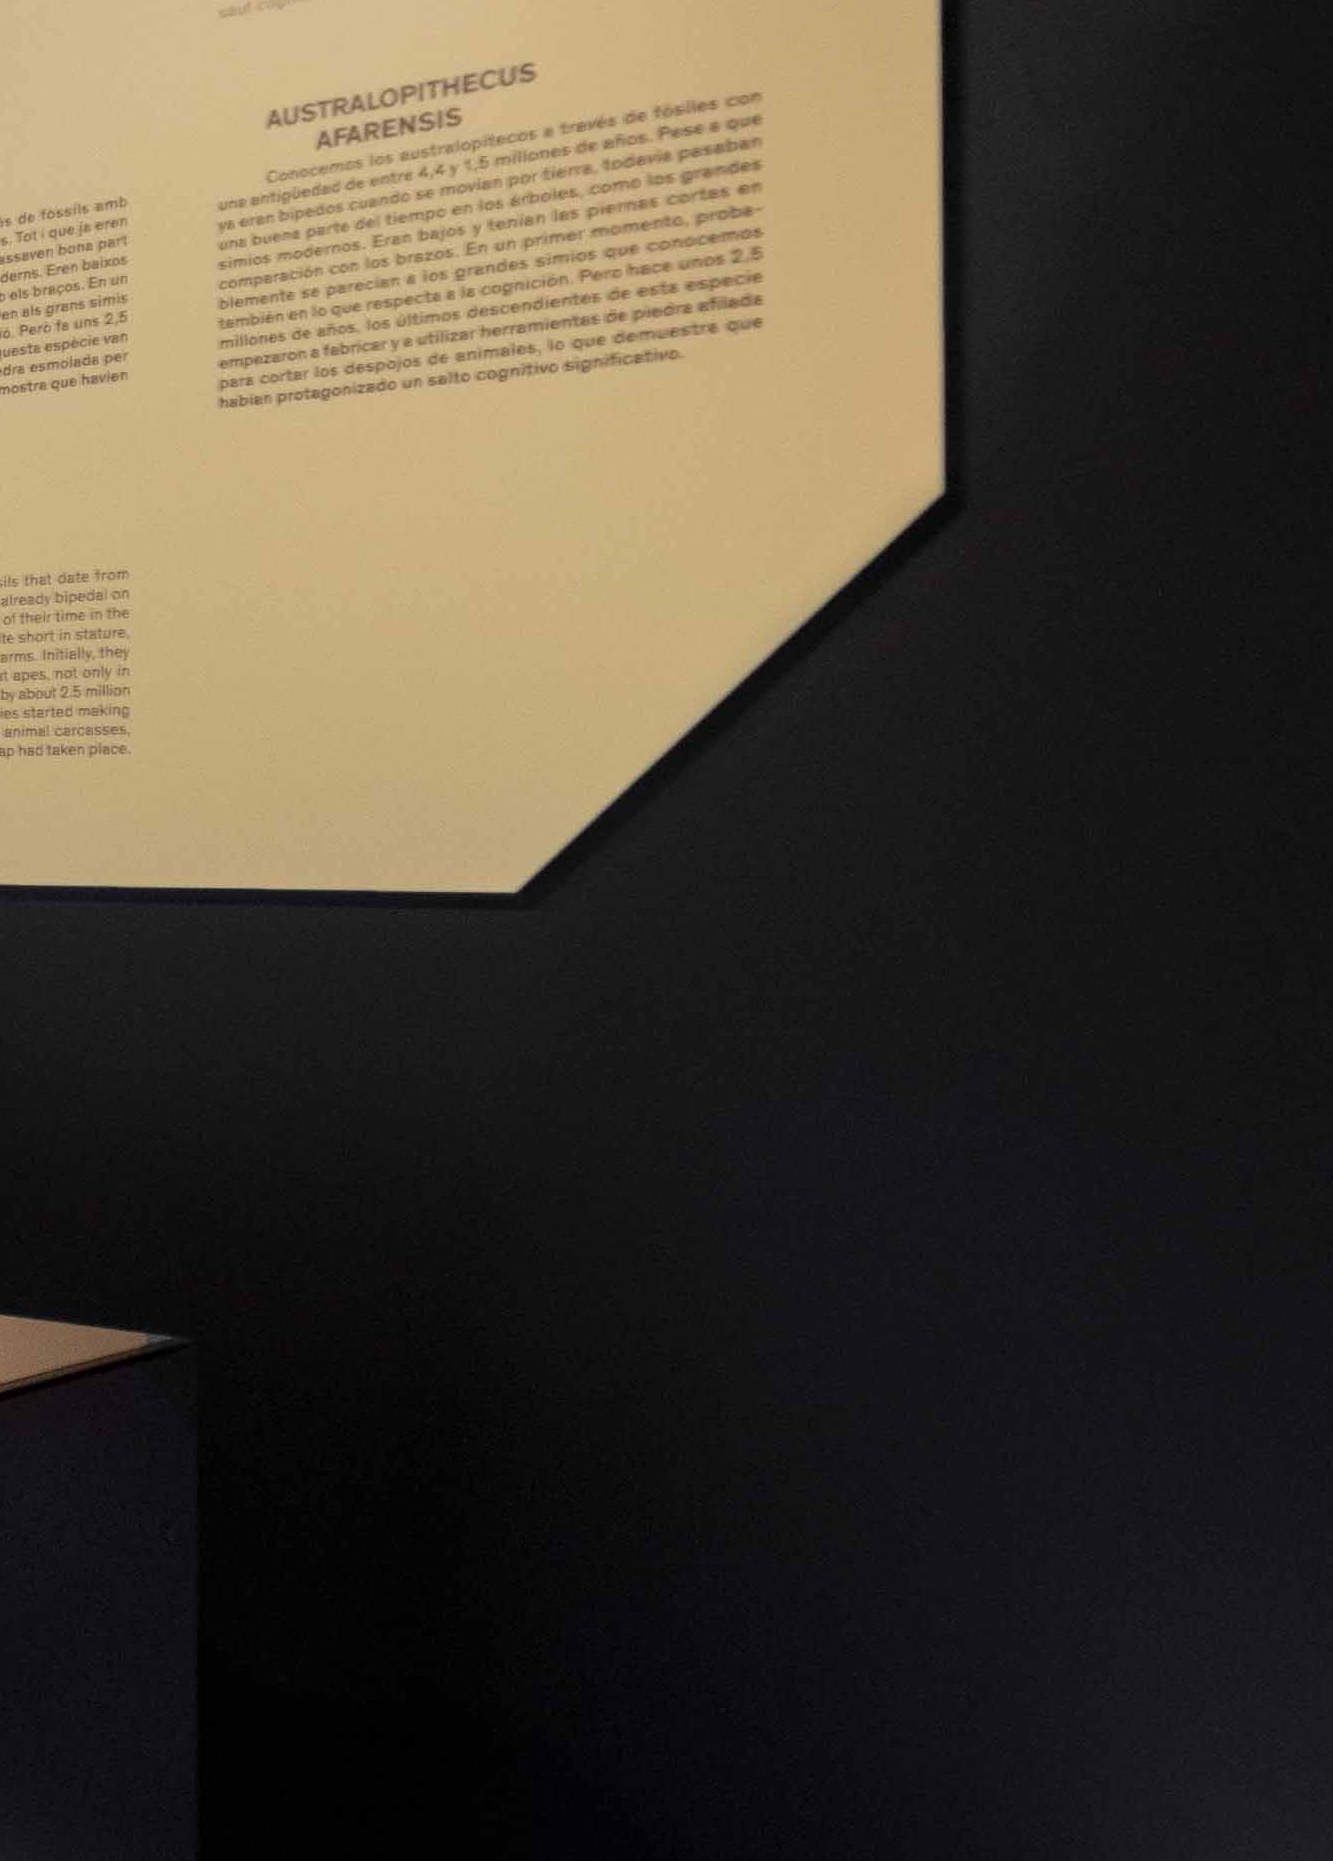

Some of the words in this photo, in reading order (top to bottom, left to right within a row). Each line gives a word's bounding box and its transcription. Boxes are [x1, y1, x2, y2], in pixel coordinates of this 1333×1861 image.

[265, 61, 538, 129] AUSTRALOPITHECUS
[315, 106, 463, 150] AFARENSIS
[16, 212, 35, 224] de
[93, 195, 128, 211] amb
[20, 304, 41, 317] als
[44, 300, 85, 317] grans
[88, 292, 128, 308] simis
[102, 332, 128, 344] van
[28, 354, 99, 372] esmolada
[102, 351, 128, 366] per
[49, 377, 77, 392] que
[79, 371, 128, 385] havien
[274, 378, 397, 405] protagonizado
[400, 377, 423, 389] un
[426, 370, 471, 386] salto
[473, 362, 559, 381] cognitivo
[561, 349, 684, 372] significativo.
[22, 572, 51, 585] that
[56, 570, 89, 583] date
[93, 568, 130, 580] from
[17, 629, 54, 642] short
[57, 629, 71, 640] in
[74, 626, 129, 639] stature,
[0, 652, 37, 662] arms.
[41, 647, 95, 660] Initially,
[98, 645, 130, 659] they
[22, 705, 73, 718] started
[76, 704, 130, 717] making
[2, 725, 49, 737] animal
[53, 726, 130, 737] carcasses,
[16, 744, 44, 756] had
[45, 743, 85, 755] taken
[86, 743, 130, 757] place.
